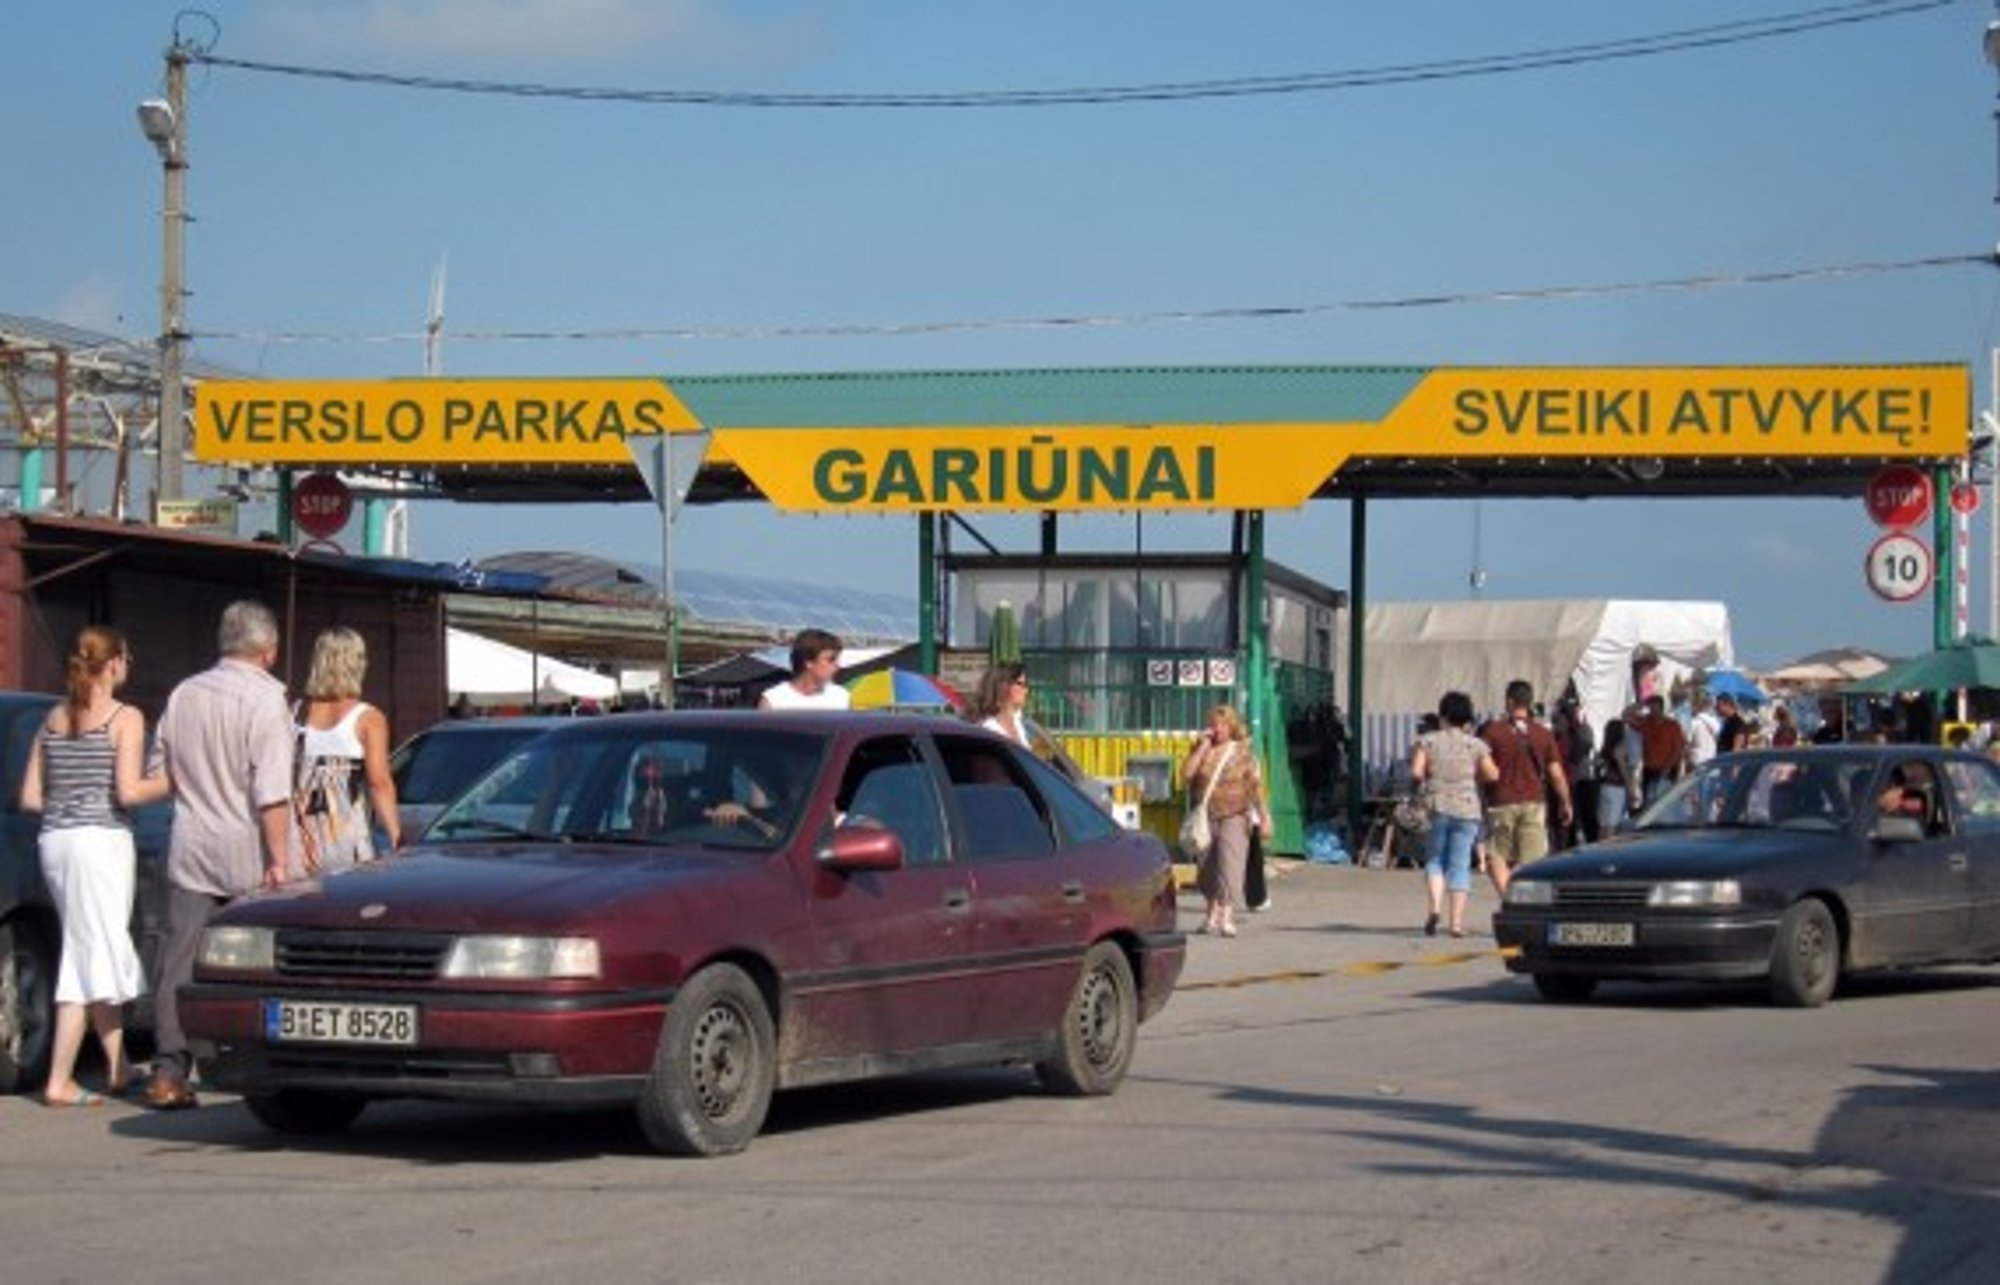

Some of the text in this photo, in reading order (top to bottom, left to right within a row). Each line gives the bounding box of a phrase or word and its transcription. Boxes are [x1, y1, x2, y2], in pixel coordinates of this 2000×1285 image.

[208, 399, 666, 444] VERSLO PARKAS
[1453, 388, 1932, 448] SVEIKI ATVYKĘ!
[812, 434, 1216, 504] GARIŪNAI
[300, 494, 342, 515] STOP
[1876, 485, 1924, 507] STOP
[1884, 554, 1919, 581] 10
[347, 1009, 411, 1041] 8528
